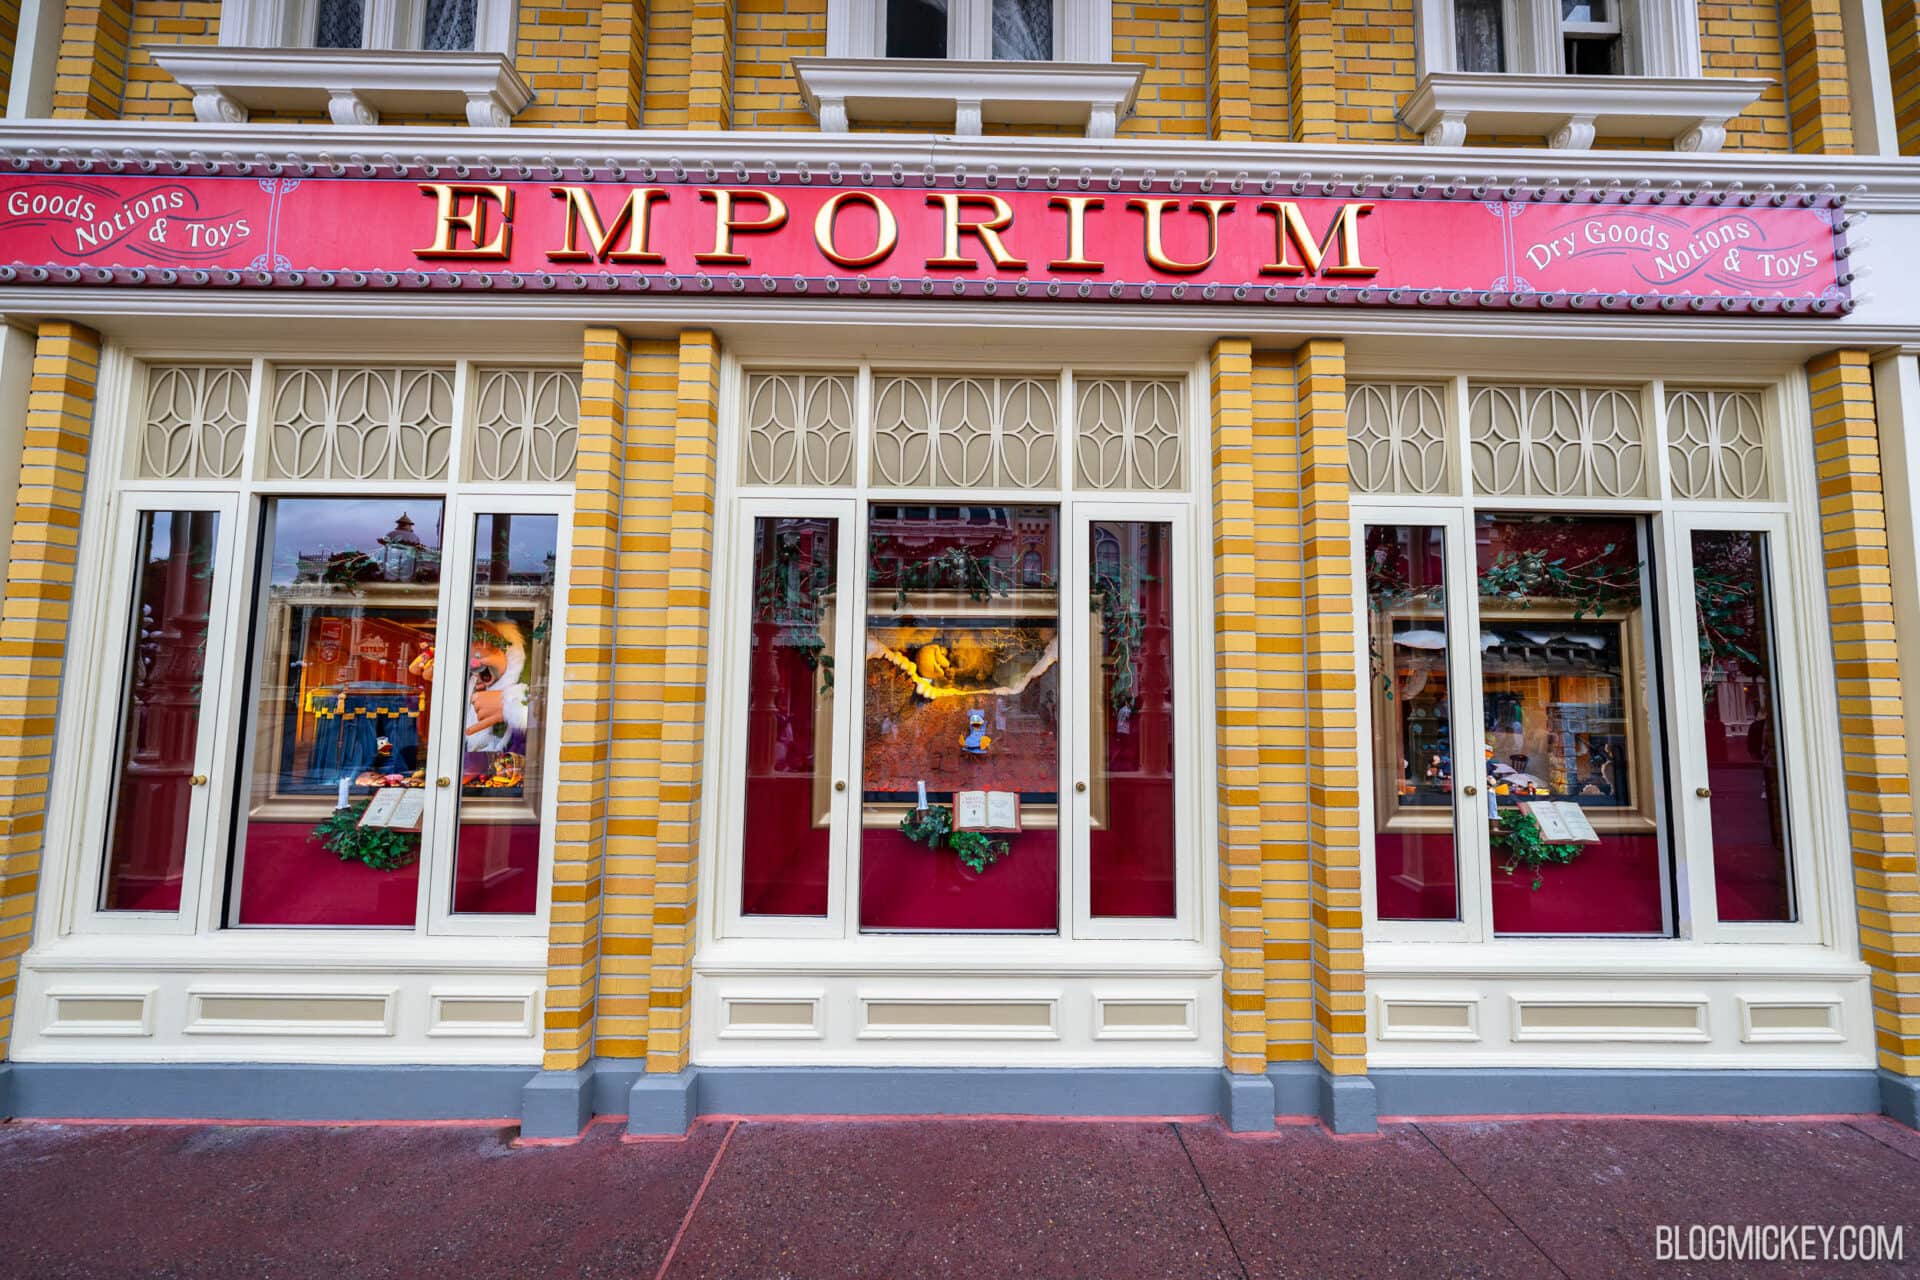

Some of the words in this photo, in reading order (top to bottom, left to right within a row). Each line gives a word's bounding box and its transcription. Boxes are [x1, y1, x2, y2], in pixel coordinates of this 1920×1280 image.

[8, 192, 96, 222] Goods
[75, 191, 184, 251] Notions
[412, 183, 1380, 277] EMPORIUM
[149, 218, 167, 243] &
[185, 219, 250, 247] Toys
[1526, 231, 1575, 271] Dry
[1584, 221, 1670, 251] Goods
[1654, 222, 1750, 279] Notions
[1722, 248, 1741, 272] &
[1757, 249, 1818, 277] Toys
